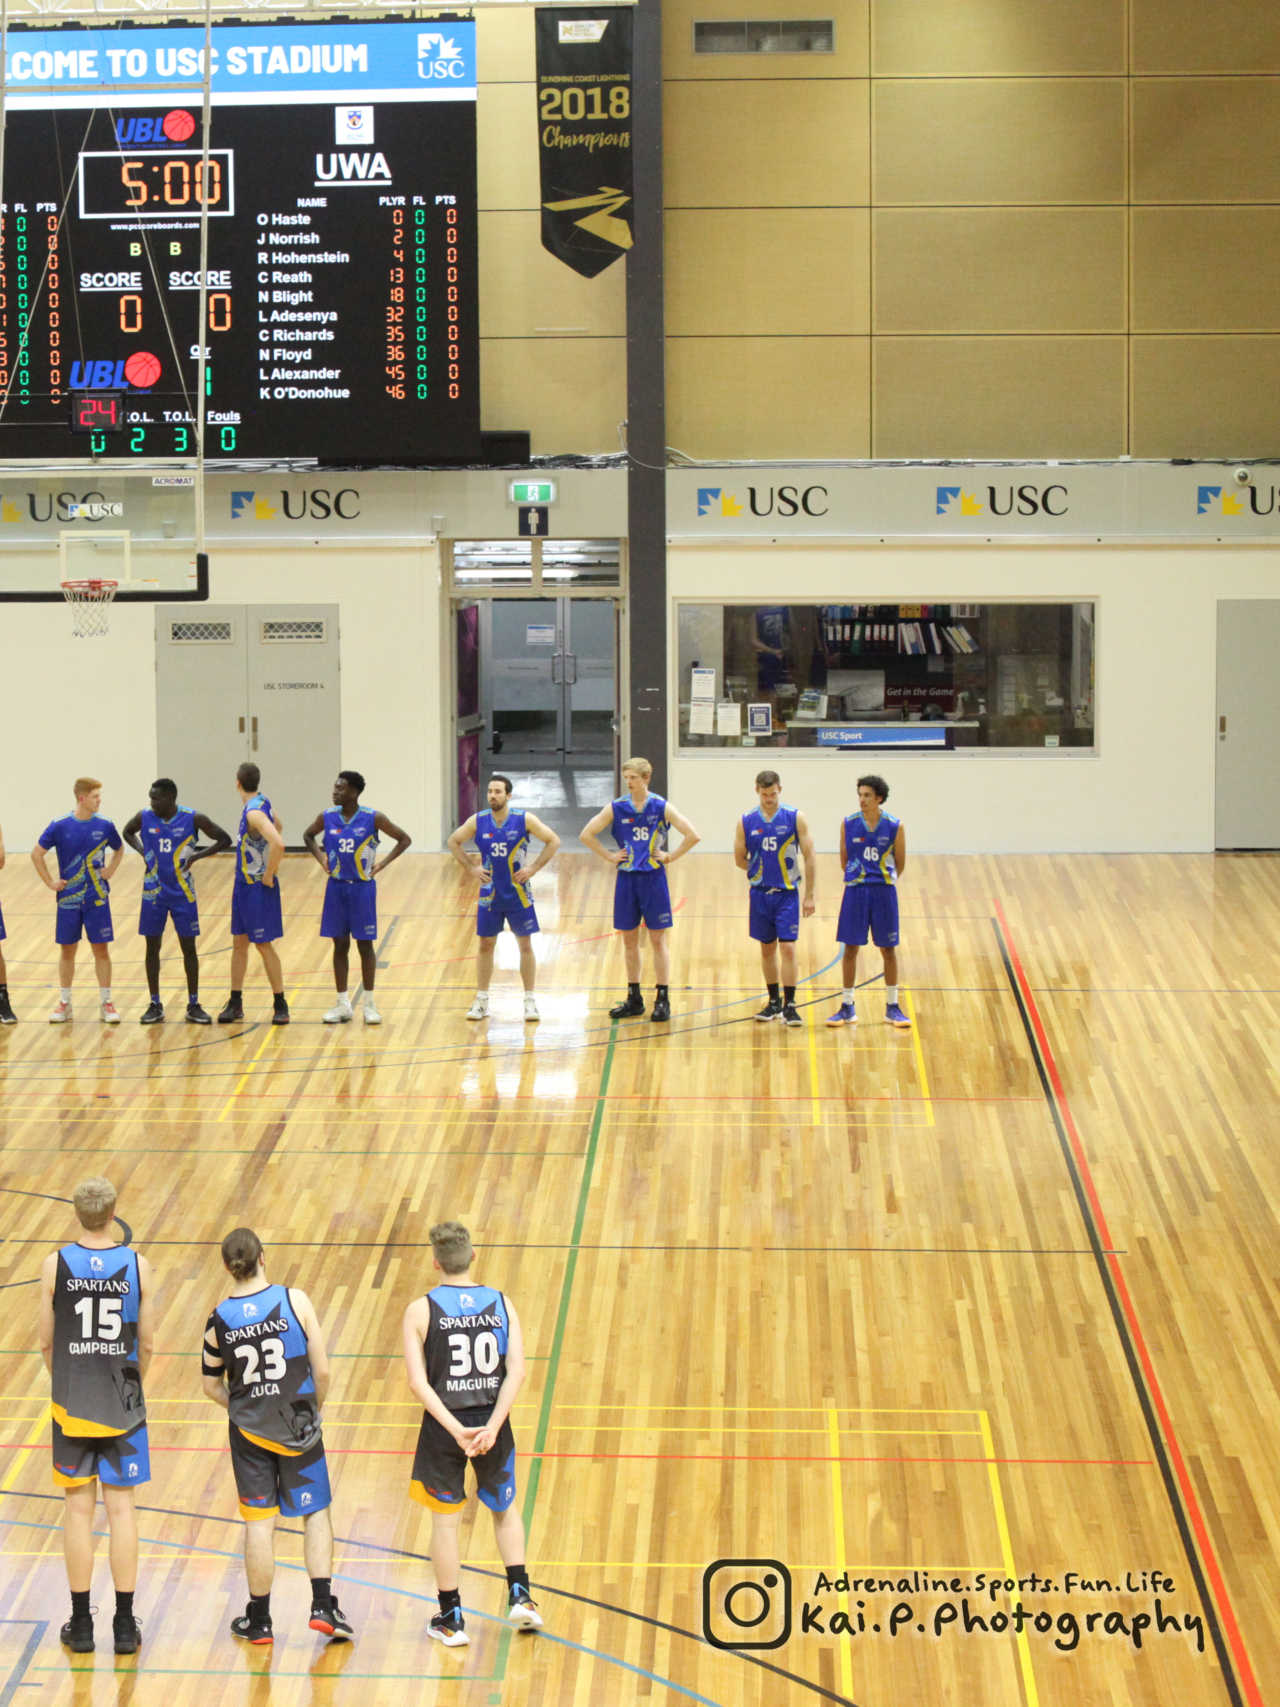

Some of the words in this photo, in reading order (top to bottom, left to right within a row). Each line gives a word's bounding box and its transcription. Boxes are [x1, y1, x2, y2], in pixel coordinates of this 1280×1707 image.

[106, 49, 147, 78] TO
[156, 48, 219, 76] USC
[226, 44, 368, 75] STADIUM
[417, 60, 465, 78] USC
[540, 86, 630, 120] 2018
[115, 117, 168, 143] UBL
[542, 125, 630, 153] Champions
[316, 152, 392, 180] UWA
[121, 160, 221, 206] 5:00
[15, 204, 27, 212] FL
[36, 203, 57, 212] PTS
[298, 198, 327, 207] NAME
[379, 197, 406, 206] PLYR
[413, 196, 426, 205] FL
[435, 196, 456, 204] PTS
[257, 214, 268, 224] O
[272, 214, 311, 224] Haste
[393, 210, 402, 224] 0
[110, 222, 199, 231] www.pcscoreboards.com
[257, 234, 264, 244] J
[269, 233, 320, 244] Norrish
[394, 229, 402, 244] 2
[130, 243, 141, 256] B
[170, 242, 181, 255] B
[394, 250, 404, 262] 4
[258, 253, 268, 264] R
[272, 252, 350, 263] Hohenstein
[80, 272, 141, 287] SCORE
[169, 271, 231, 285] SCORE
[258, 272, 268, 283] C
[273, 272, 312, 282] Reath
[390, 268, 404, 283] 13
[259, 292, 268, 302] N
[273, 291, 313, 305] Blight
[390, 287, 404, 302] 18
[120, 295, 142, 332] 0
[209, 294, 231, 331] 0
[259, 311, 268, 322] L
[270, 310, 338, 324] Adesenya
[386, 306, 404, 322] 32
[259, 330, 270, 341] C
[274, 329, 334, 340] Richards
[386, 326, 404, 342] 35
[260, 350, 269, 360] N
[274, 348, 312, 363] Floyd
[386, 346, 404, 360] 36
[69, 360, 129, 388] UBL
[260, 369, 268, 380] L
[271, 368, 341, 380] Alexander
[386, 365, 404, 380] 45
[206, 367, 211, 396] 1
[260, 388, 270, 399] K
[274, 388, 350, 398] O'Donohue
[386, 384, 405, 400] 46
[79, 400, 116, 425] 24
[163, 411, 196, 421] T.O.L.
[207, 411, 240, 421] Fouls
[130, 428, 144, 451] 2
[175, 428, 187, 451] 3
[221, 427, 235, 450] 0
[280, 489, 360, 520] USC
[747, 486, 828, 516] USC
[987, 485, 1069, 516] USC
[89, 504, 121, 516] USC
[887, 688, 901, 696] Get
[903, 687, 910, 695] in
[913, 687, 927, 695] the
[930, 687, 953, 696] Game
[822, 731, 838, 740] USC
[840, 731, 862, 741] Sport
[633, 827, 649, 841] 36
[159, 838, 171, 852] 13
[339, 838, 354, 853] 32
[491, 843, 507, 856] 35
[762, 837, 777, 851] 45
[864, 847, 879, 861] 46
[67, 1279, 129, 1293] SPARTANS
[74, 1297, 122, 1340] 15
[439, 1315, 501, 1329] SPARTANS
[225, 1319, 288, 1344] SPARTANS
[69, 1342, 127, 1355] CAMPBELL
[448, 1332, 499, 1377] 30
[234, 1338, 286, 1385] 23
[251, 1383, 280, 1398] LUCA
[447, 1377, 499, 1391] MAGUIRE
